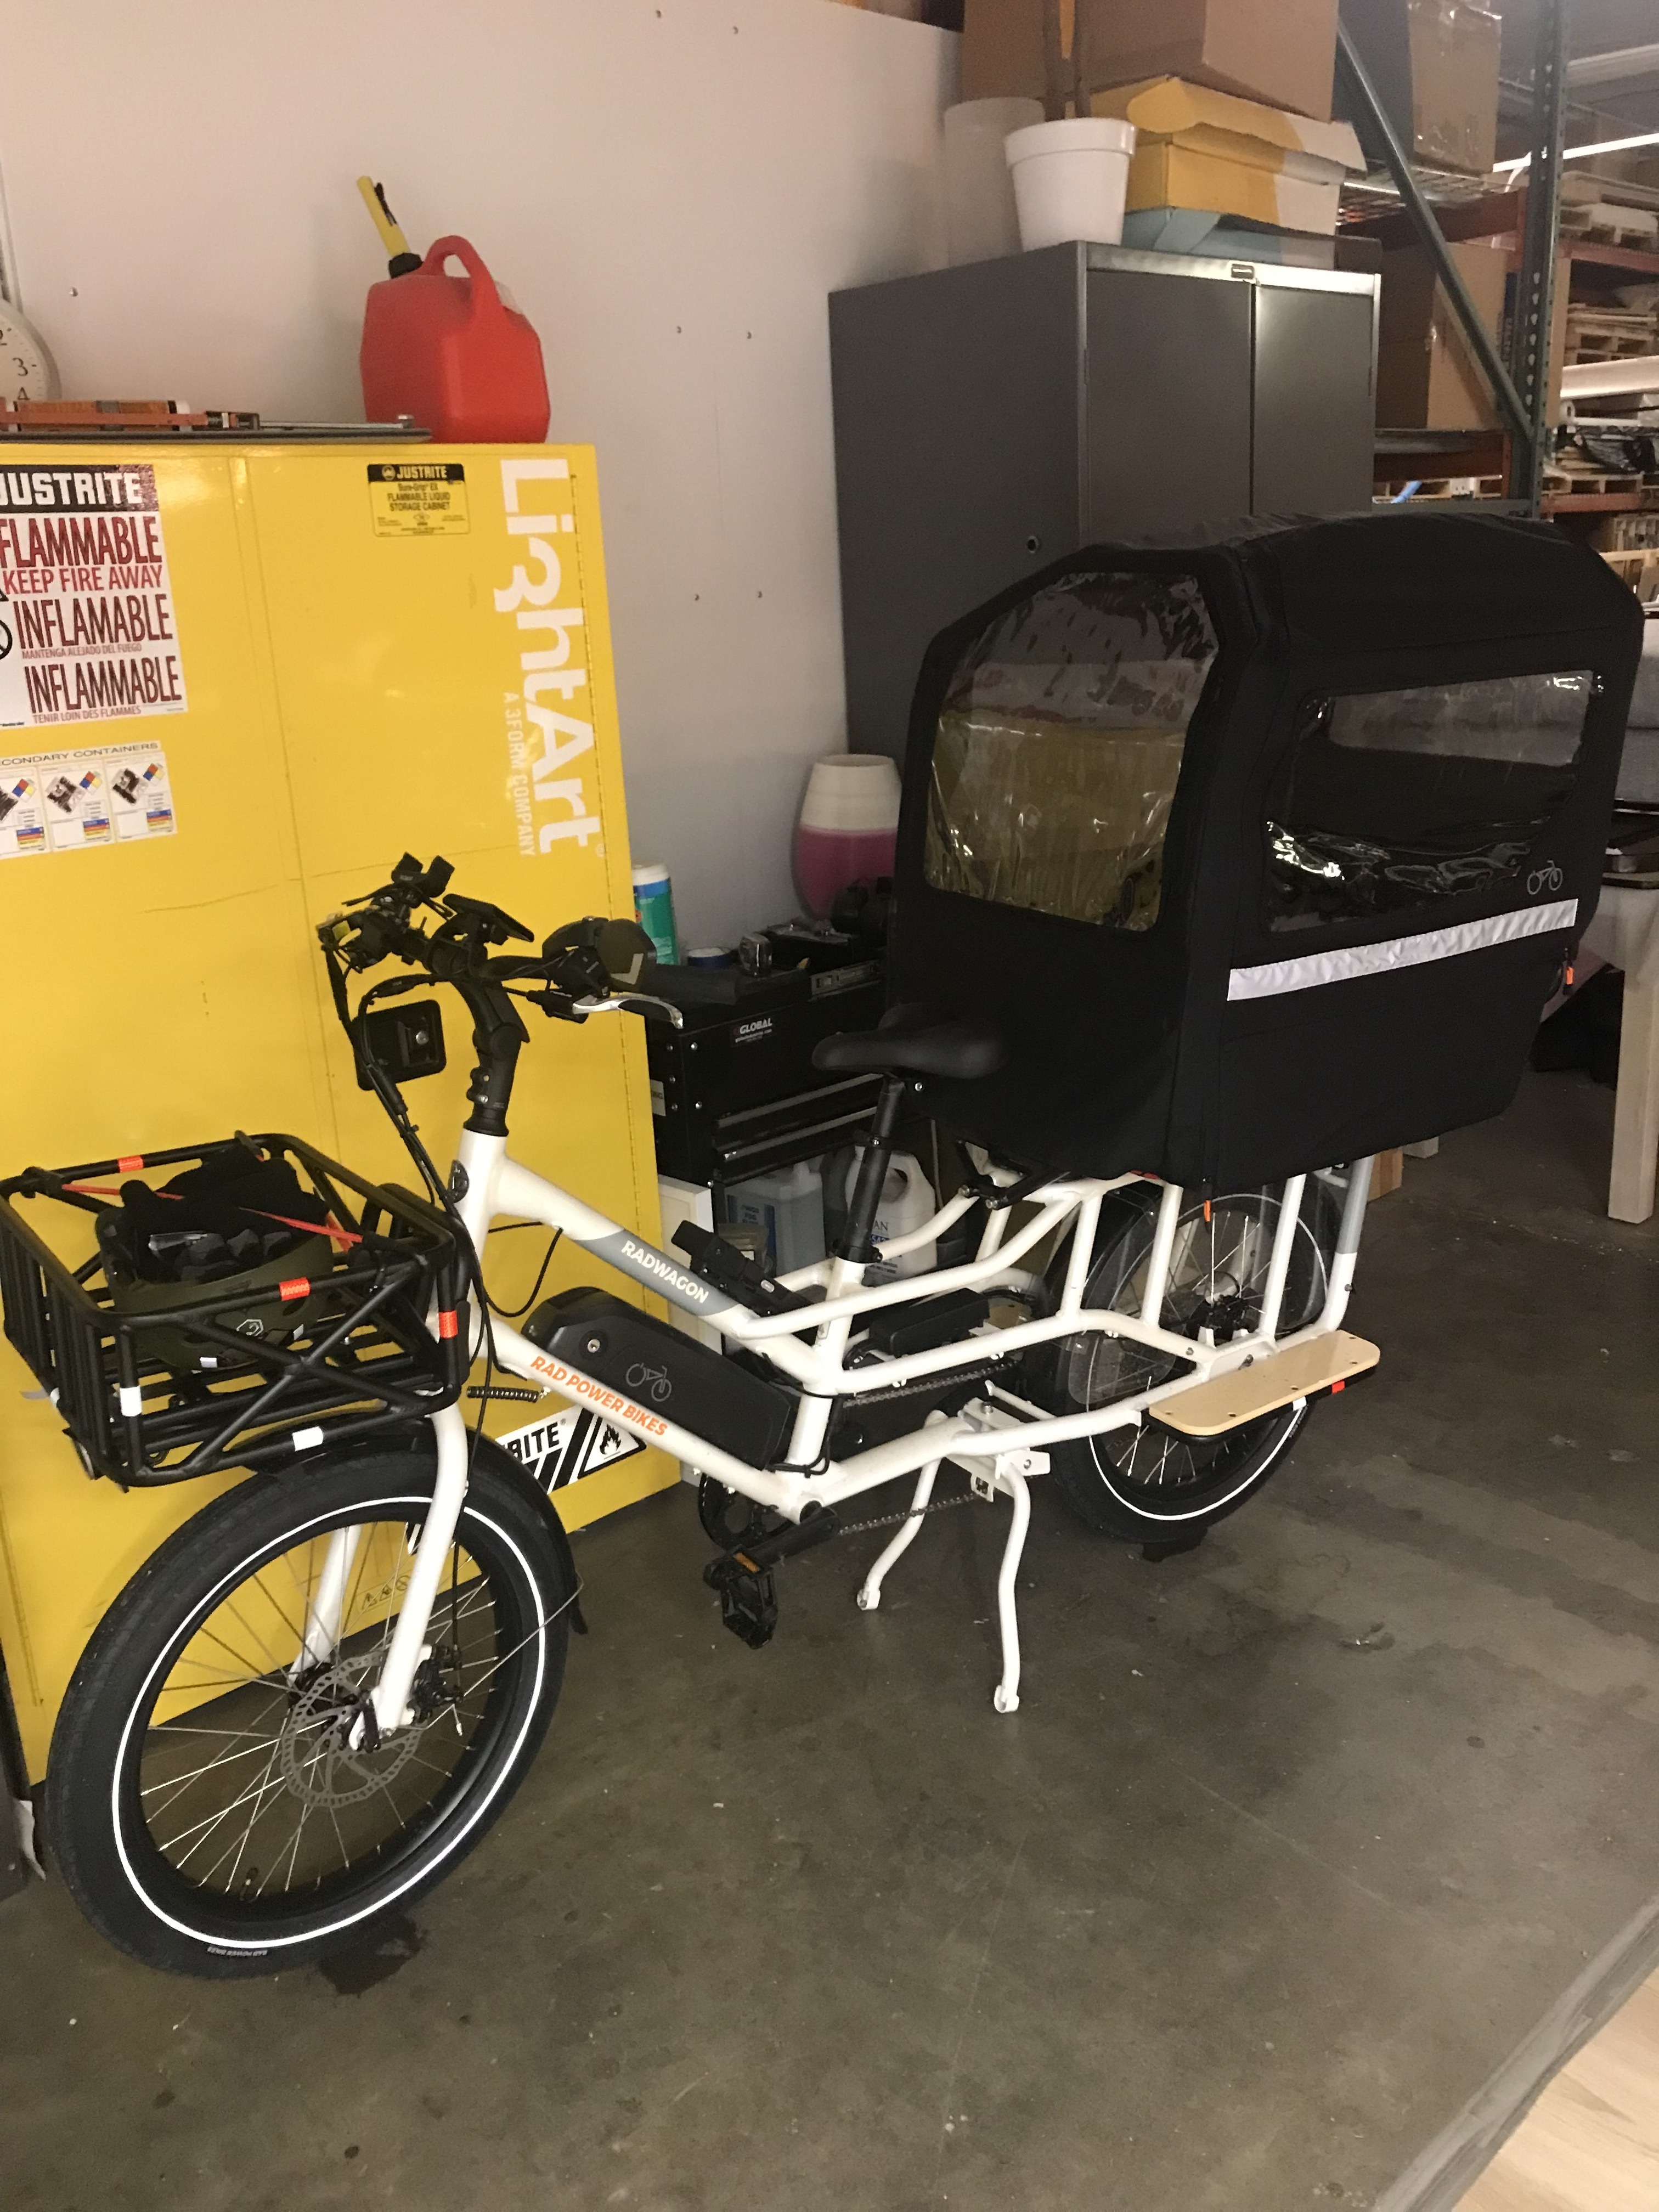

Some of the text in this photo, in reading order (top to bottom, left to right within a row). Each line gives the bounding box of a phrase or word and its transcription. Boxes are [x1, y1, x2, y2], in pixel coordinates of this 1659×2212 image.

[13, 357, 29, 376] 3
[397, 465, 447, 479] JUSTRITE
[390, 501, 450, 511] STORAGE CABINET
[2, 565, 162, 594] KEEP FIRE AWAY
[13, 594, 173, 649] INFLAMABLE
[22, 643, 142, 659] MANTENGA ALEJADO DEL FUEGO
[25, 656, 182, 714] INFLAMMABLE
[32, 714, 59, 724] TENIR
[61, 711, 82, 721] LOIN
[83, 708, 100, 719] DES
[100, 706, 142, 718] FLAMMES
[73, 742, 159, 758] CONTAINERS
[503, 692, 535, 856] A 3FORM COMPANY
[740, 1018, 773, 1034] GLOBAL
[621, 1240, 709, 1304] RADWAGON
[531, 1356, 668, 1436] RAD POWER BIKES
[506, 1421, 560, 1463] RITE
